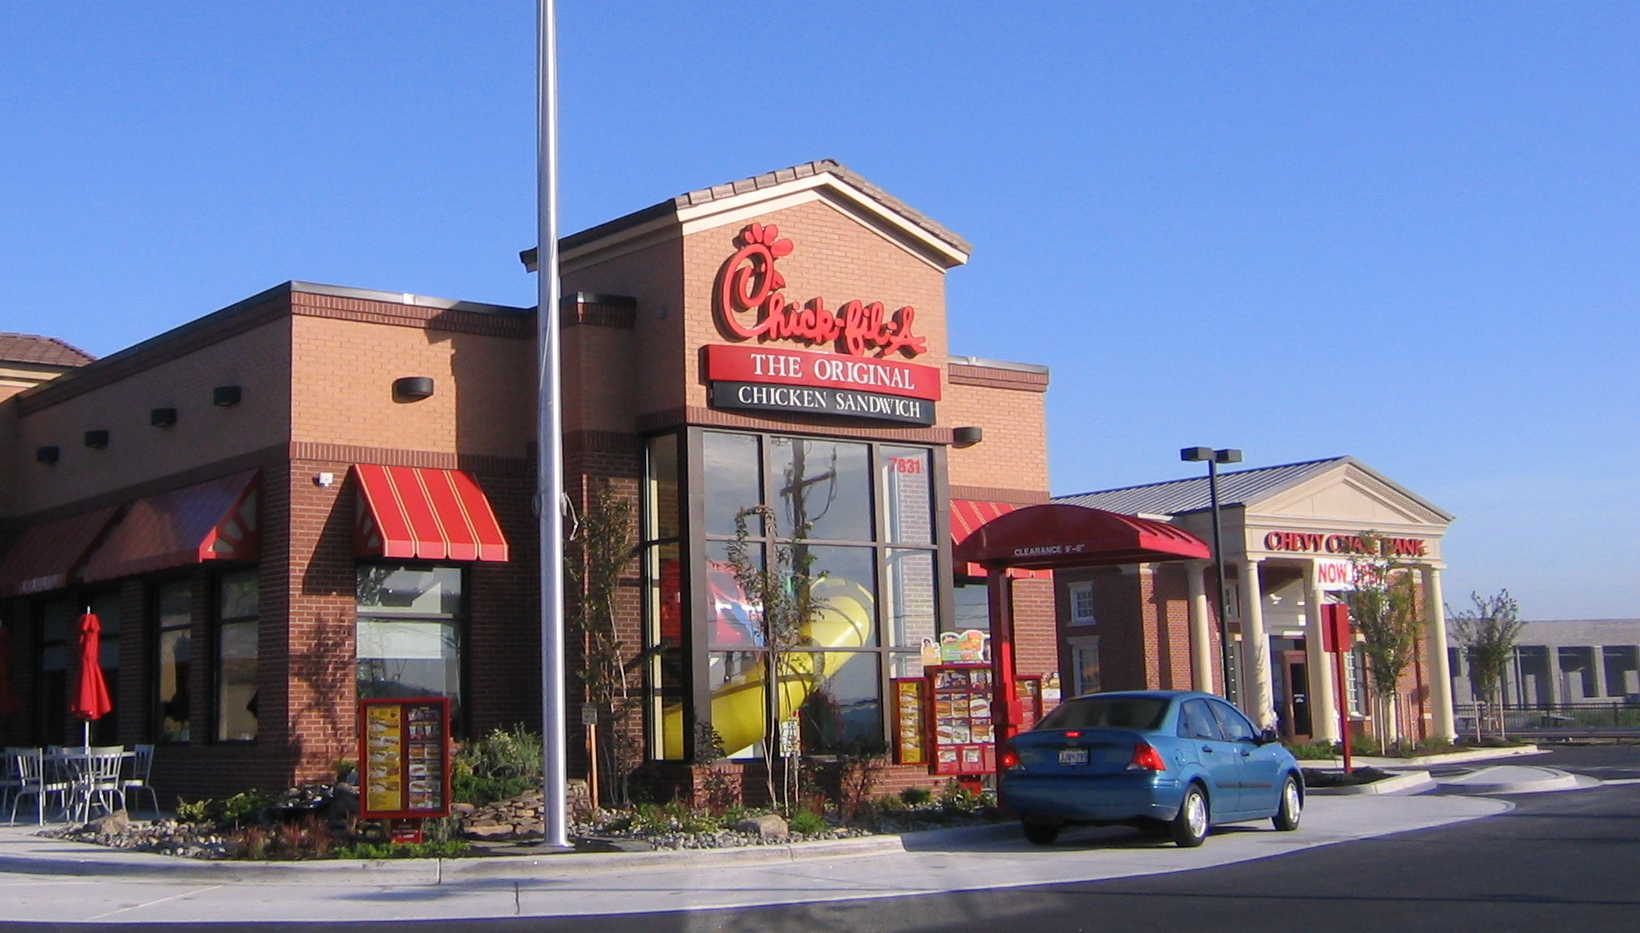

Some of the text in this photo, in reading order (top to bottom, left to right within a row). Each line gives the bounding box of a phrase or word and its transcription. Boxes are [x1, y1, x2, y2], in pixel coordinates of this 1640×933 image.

[719, 222, 928, 357] Chick-fil-A
[750, 353, 916, 391] THE ORIGINAL
[737, 385, 922, 418] CHICKEN SANDWICH
[888, 455, 922, 474] 7831
[1014, 546, 1062, 557] CLEARANCE
[1263, 531, 1325, 552] CHEVY
[1318, 562, 1347, 583] NOW
